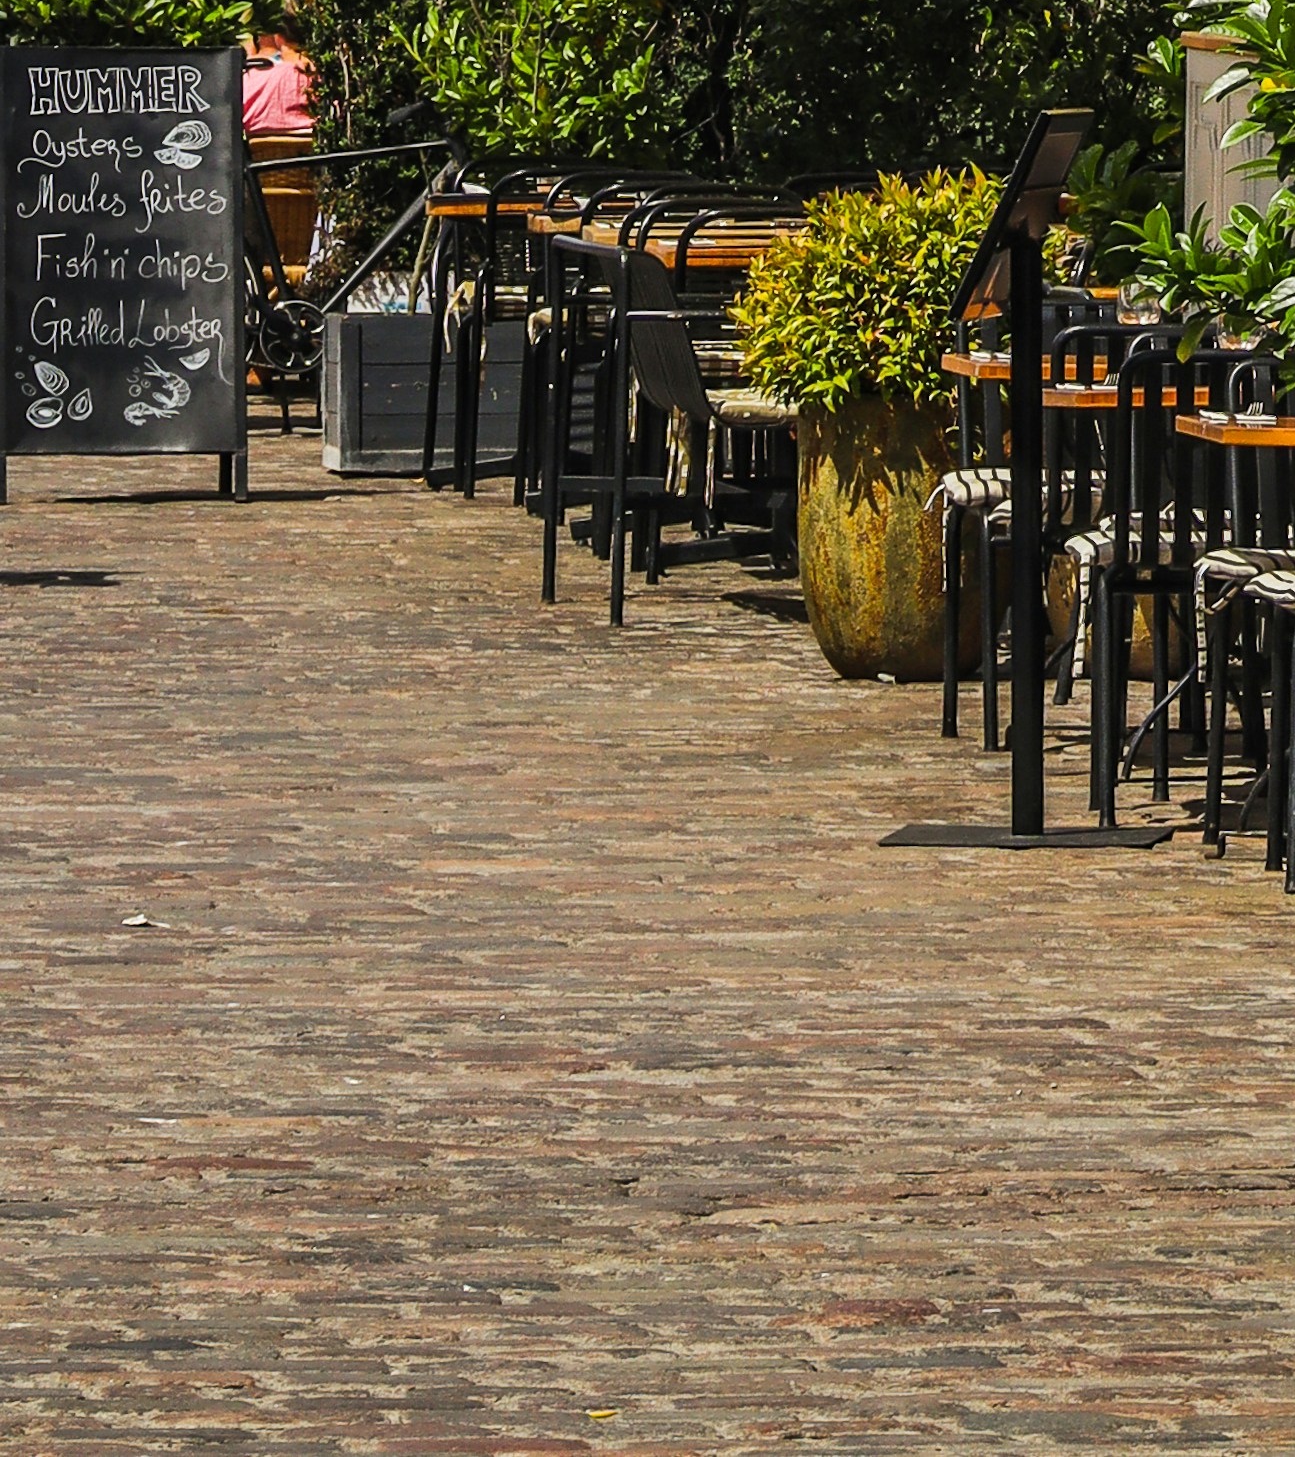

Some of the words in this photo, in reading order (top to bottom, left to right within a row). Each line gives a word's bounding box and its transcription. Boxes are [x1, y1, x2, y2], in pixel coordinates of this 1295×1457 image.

[28, 66, 210, 116] HUMMER
[17, 129, 144, 173] Oysters
[17, 173, 127, 219] Moules
[35, 232, 98, 283] Fish
[30, 296, 125, 354] Grilled
[128, 298, 234, 386] Lobster
